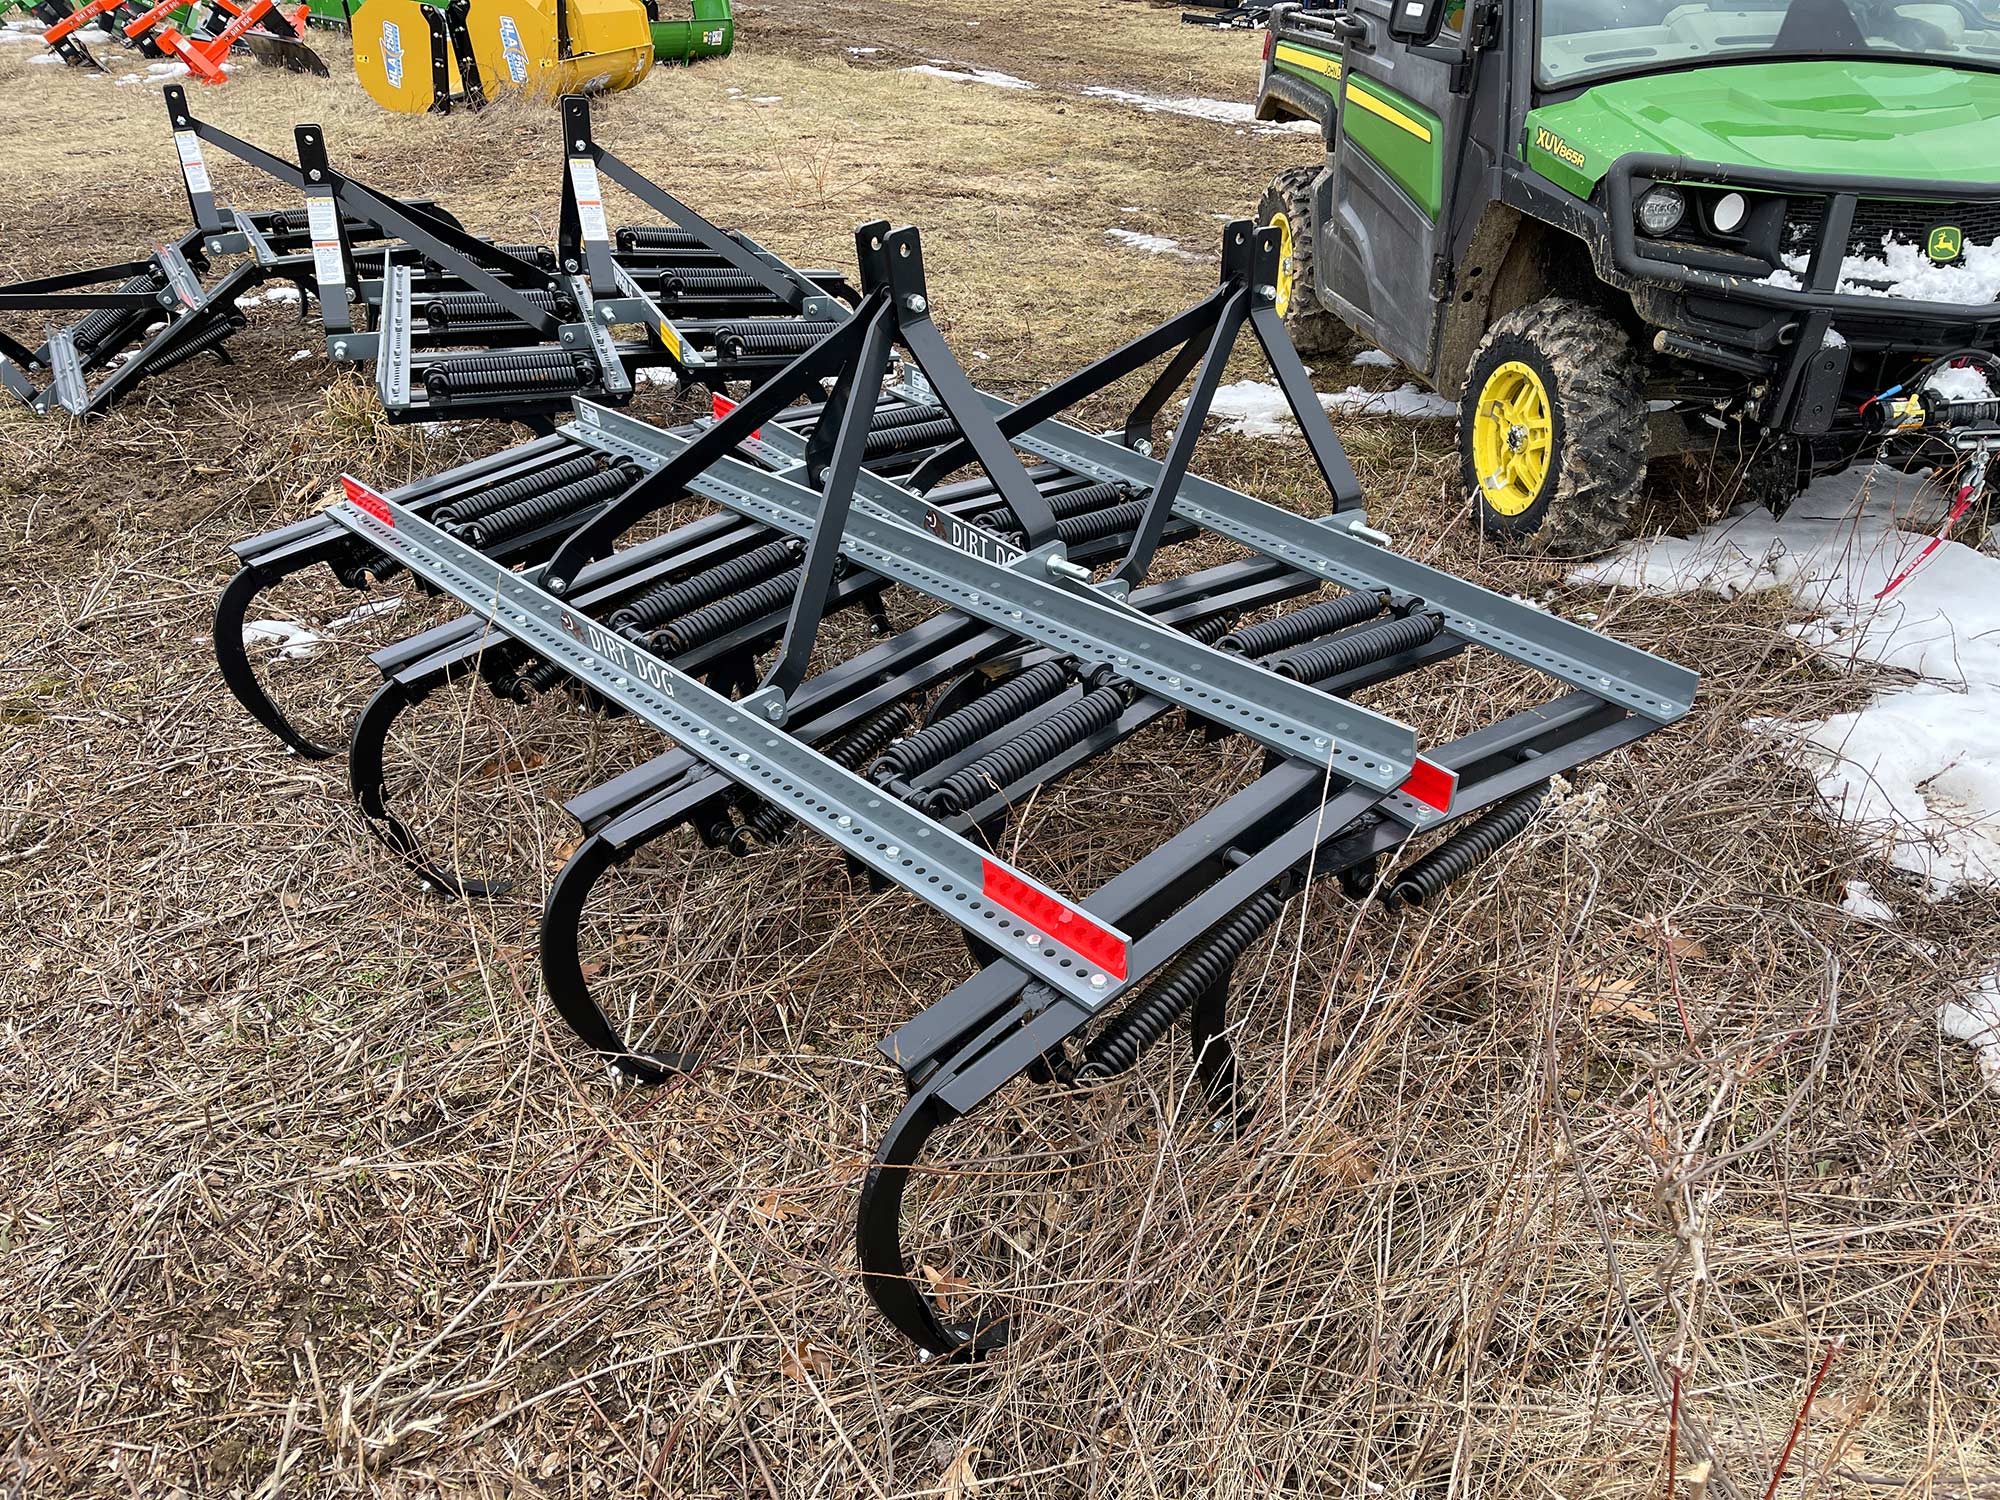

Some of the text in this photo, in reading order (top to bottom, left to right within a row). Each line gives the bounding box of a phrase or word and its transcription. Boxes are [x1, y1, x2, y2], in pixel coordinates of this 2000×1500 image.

[230, 24, 242, 36] DIRT
[501, 17, 519, 48] HLA
[384, 22, 400, 87] HLA 2500
[1536, 126, 1586, 168] XUV865R
[951, 520, 988, 560] DIRT
[587, 624, 675, 698] DIRT DOG
